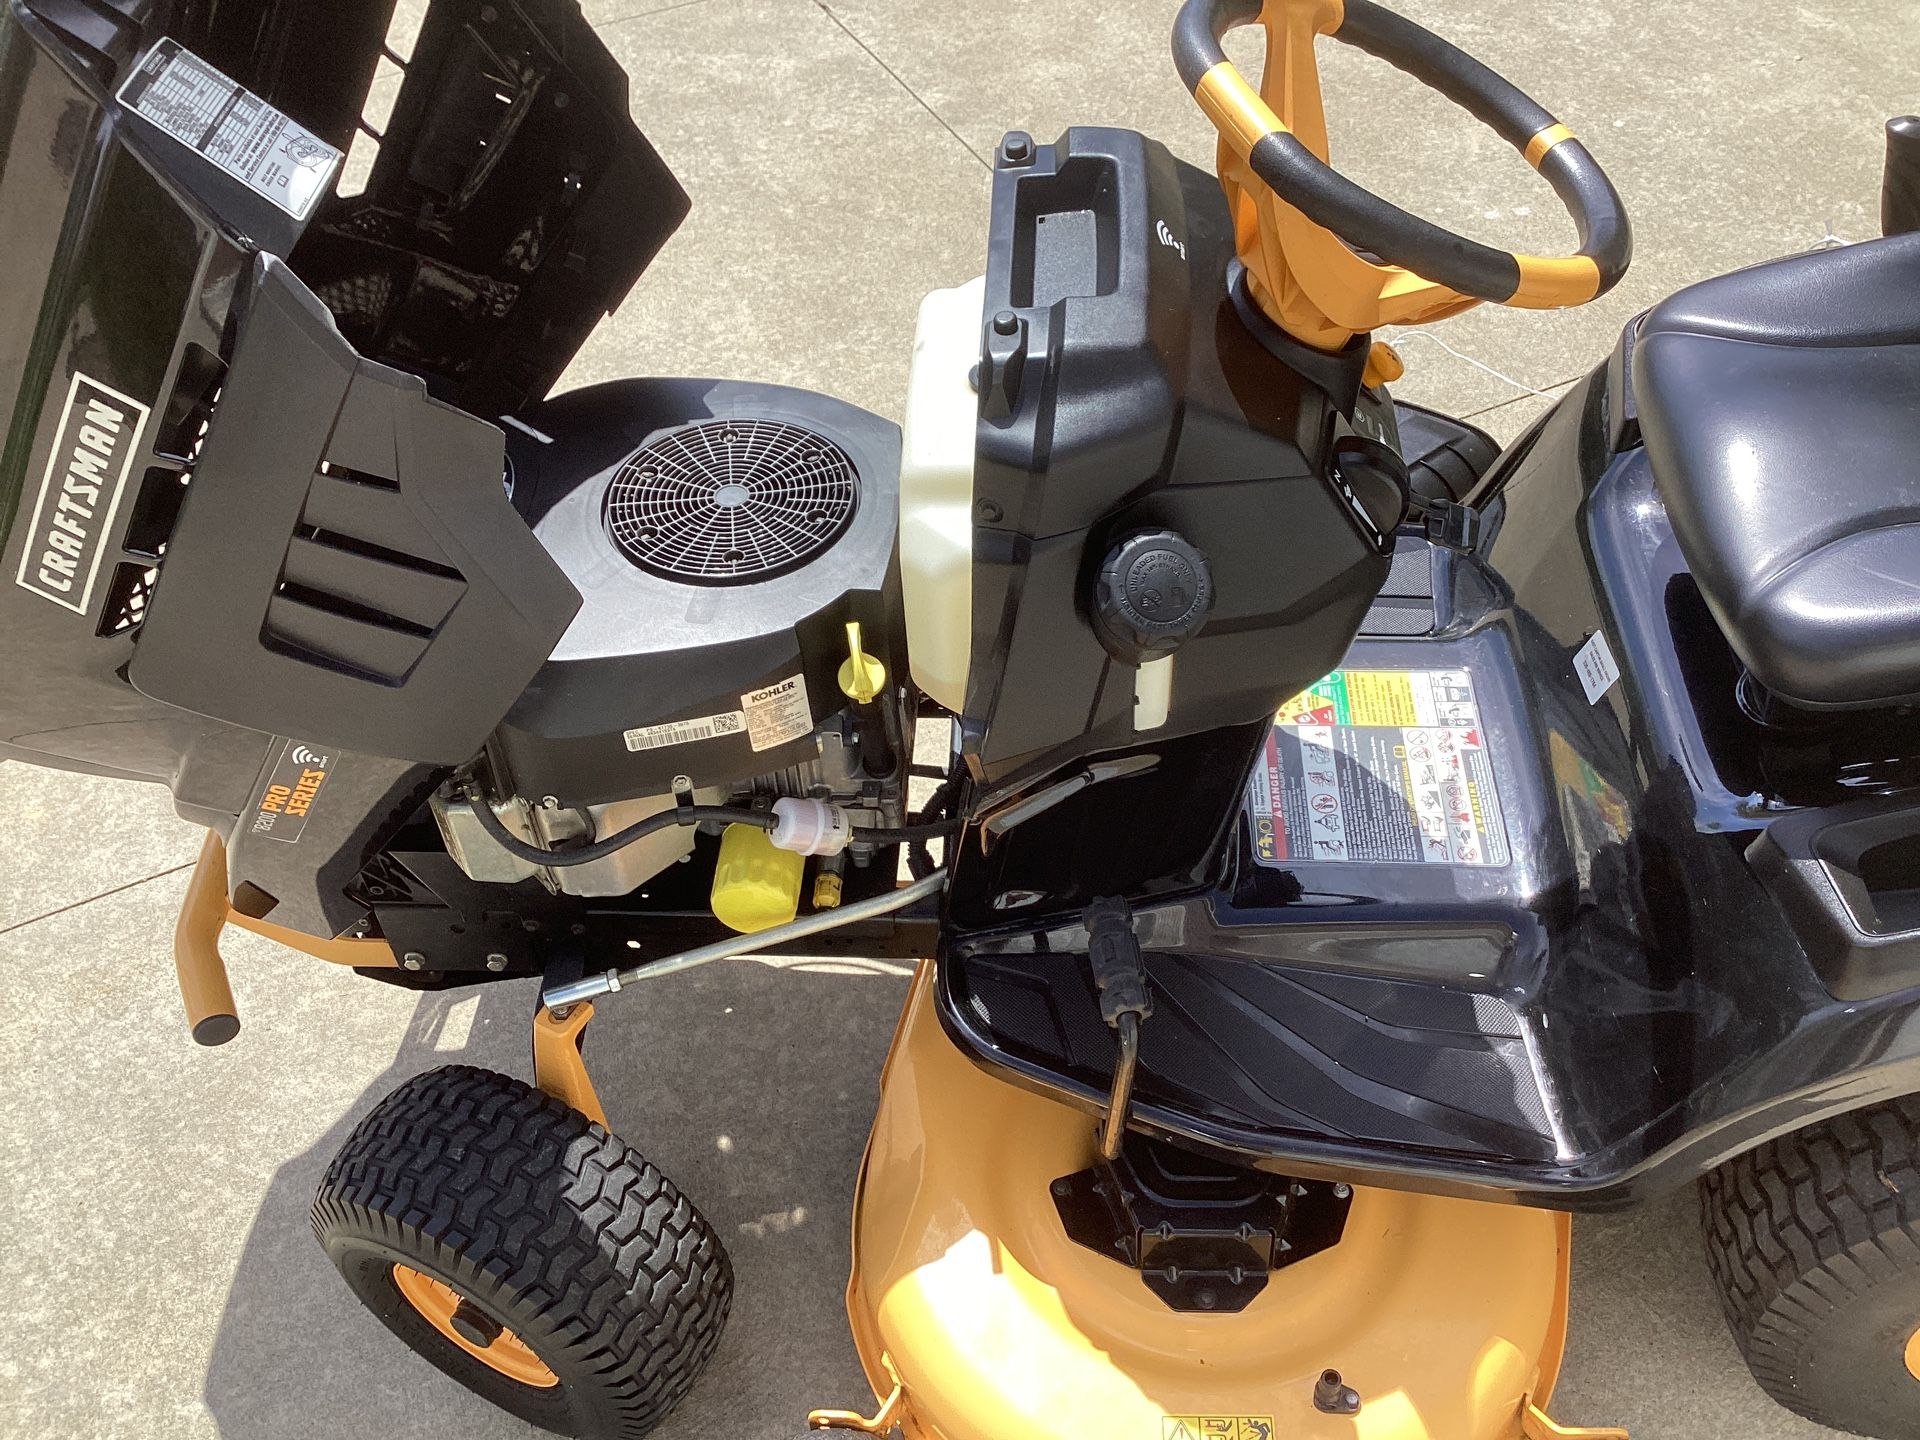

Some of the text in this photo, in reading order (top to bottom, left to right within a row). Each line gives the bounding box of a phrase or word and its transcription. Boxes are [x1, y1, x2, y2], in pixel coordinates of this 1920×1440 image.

[38, 398, 124, 592] CRAFTSMAN
[1129, 553, 1156, 592] UNLEADED
[1157, 553, 1178, 565] FUEL
[751, 681, 795, 703] KOHLER
[319, 755, 329, 769] smart
[1275, 747, 1283, 762] DEATH
[284, 768, 326, 817] SERIES
[1268, 766, 1281, 808] DANGER
[1278, 771, 1286, 788] INJURY
[261, 784, 291, 813] PRO
[1280, 789, 1288, 810] SERIOUS
[1467, 781, 1482, 824] WARNING
